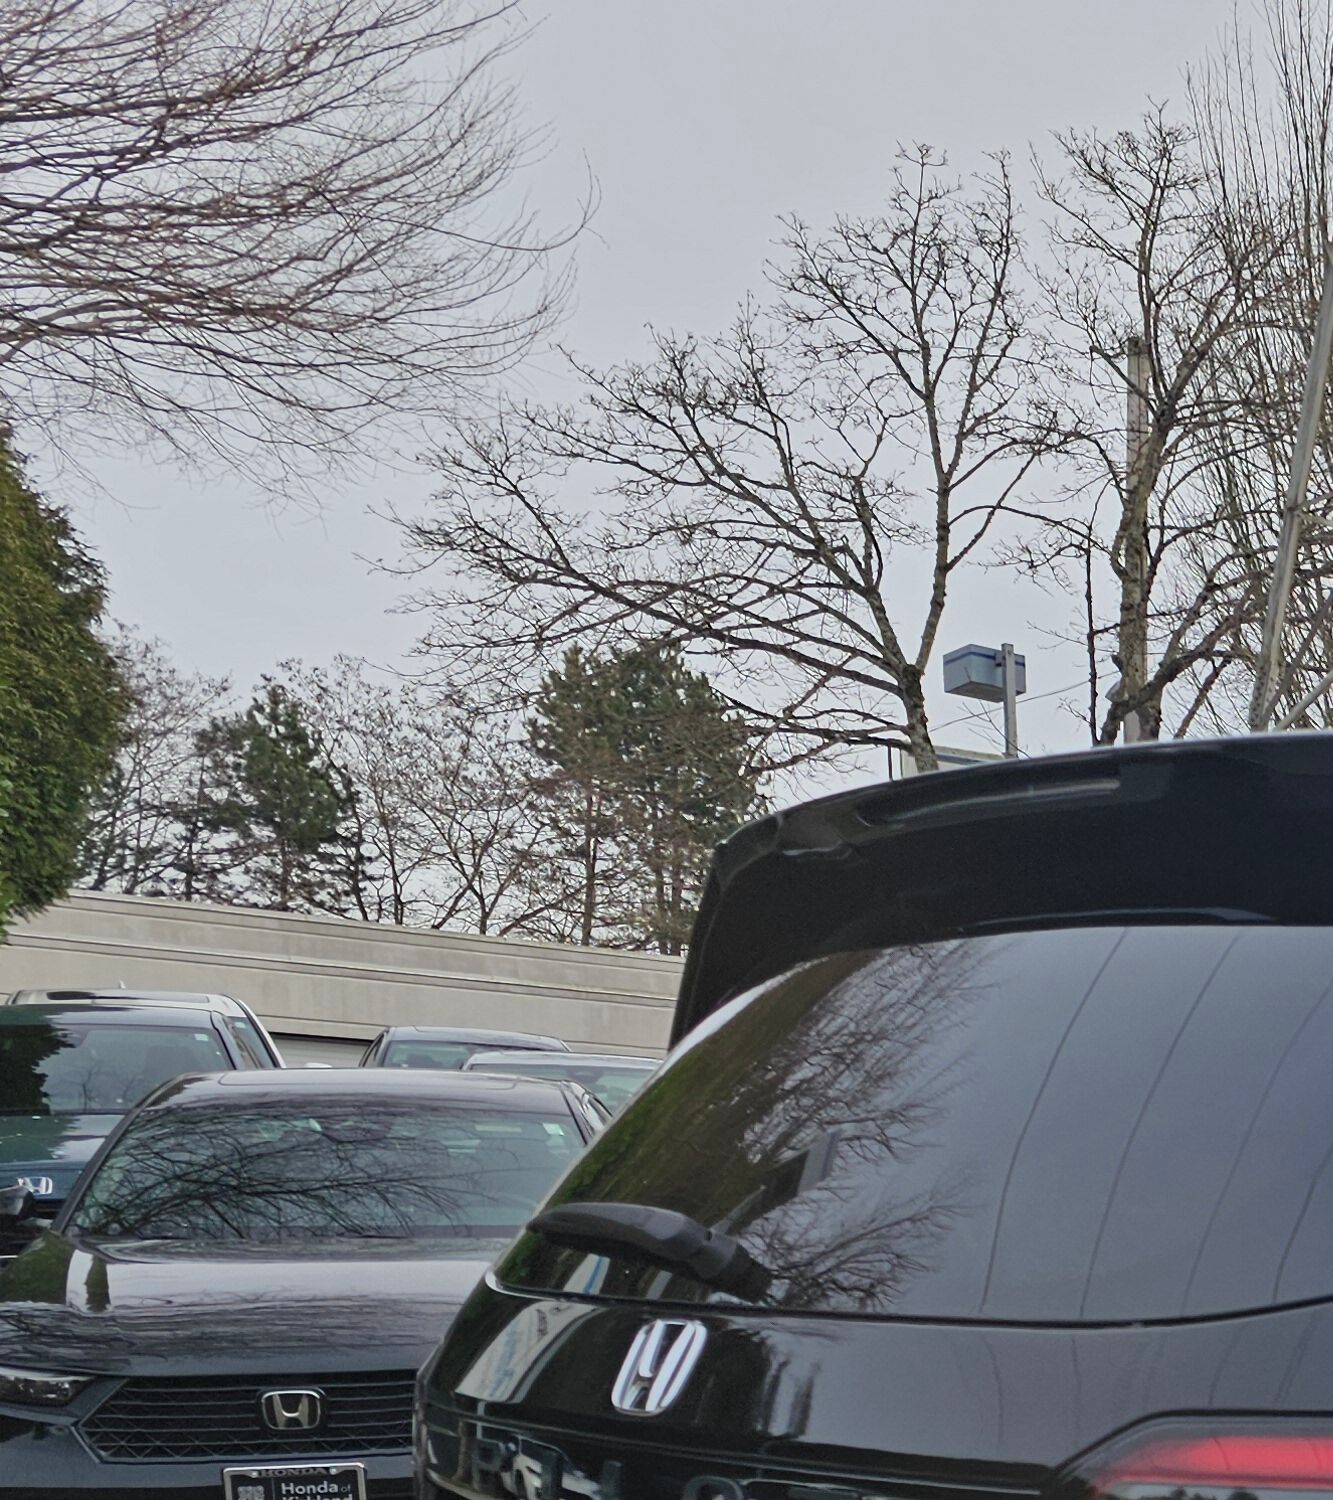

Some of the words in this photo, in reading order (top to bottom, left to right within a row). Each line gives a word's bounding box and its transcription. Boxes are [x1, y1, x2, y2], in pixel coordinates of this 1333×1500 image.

[261, 1467, 328, 1477] HONDA
[281, 1481, 339, 1494] Honda
[341, 1484, 352, 1494] of
